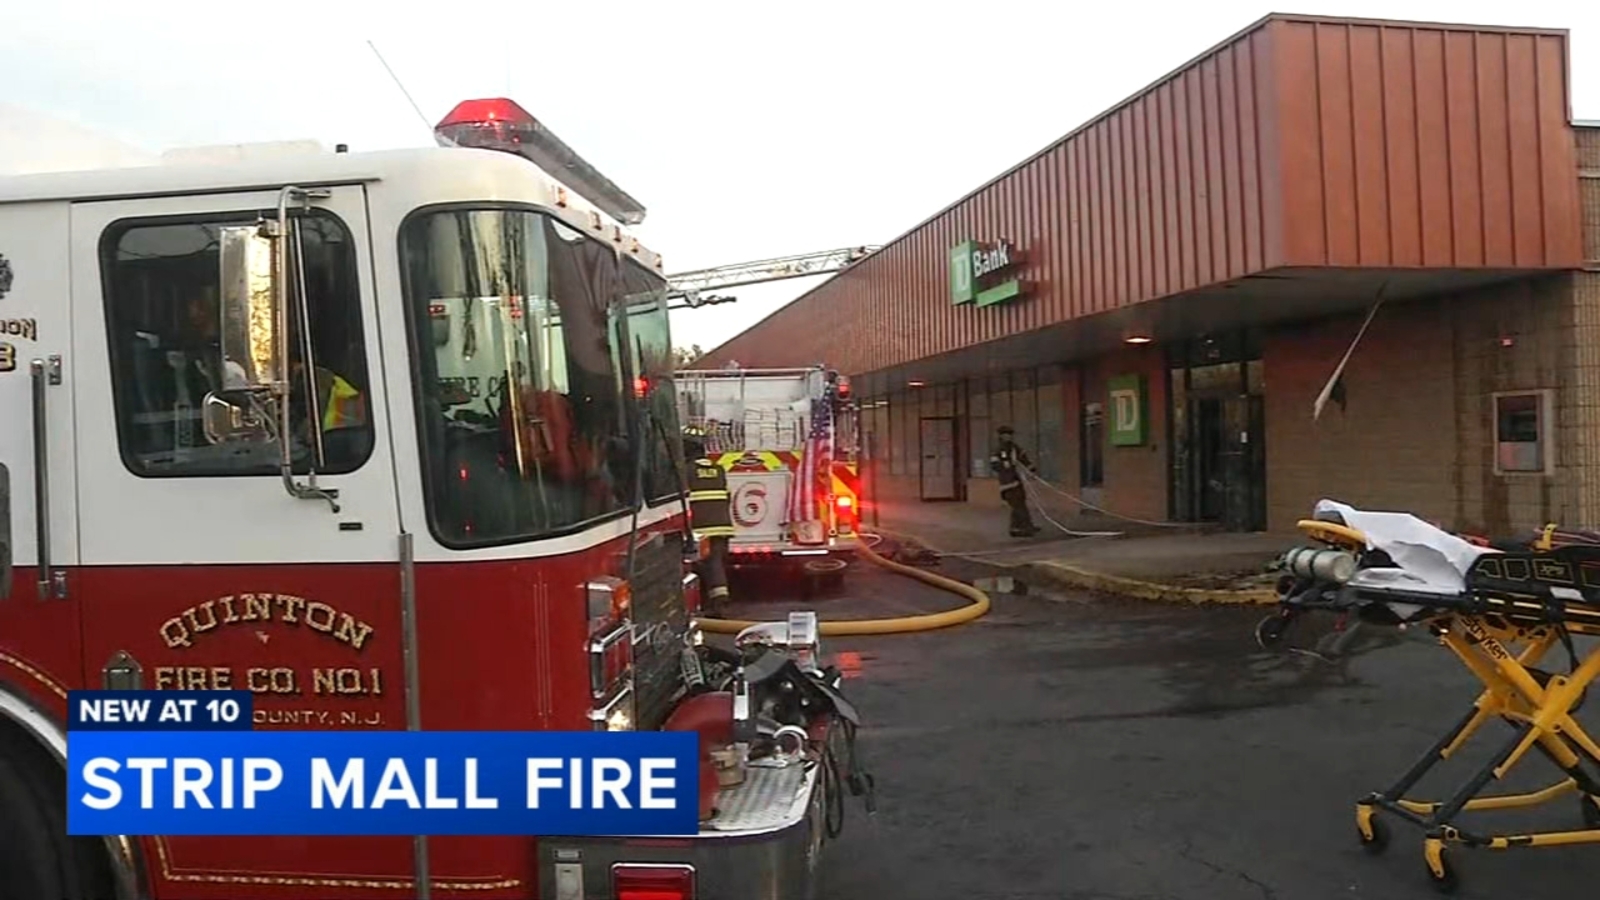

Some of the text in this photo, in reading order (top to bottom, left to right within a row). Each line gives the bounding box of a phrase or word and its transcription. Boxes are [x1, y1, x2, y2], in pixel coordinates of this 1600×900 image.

[973, 239, 1009, 278] Bank
[1110, 389, 1141, 431] TD
[733, 481, 769, 527] 6
[159, 593, 374, 649] QUINTON
[155, 667, 381, 694] FIRE CO. NO.1
[252, 710, 386, 725] OUNTY, N.J.
